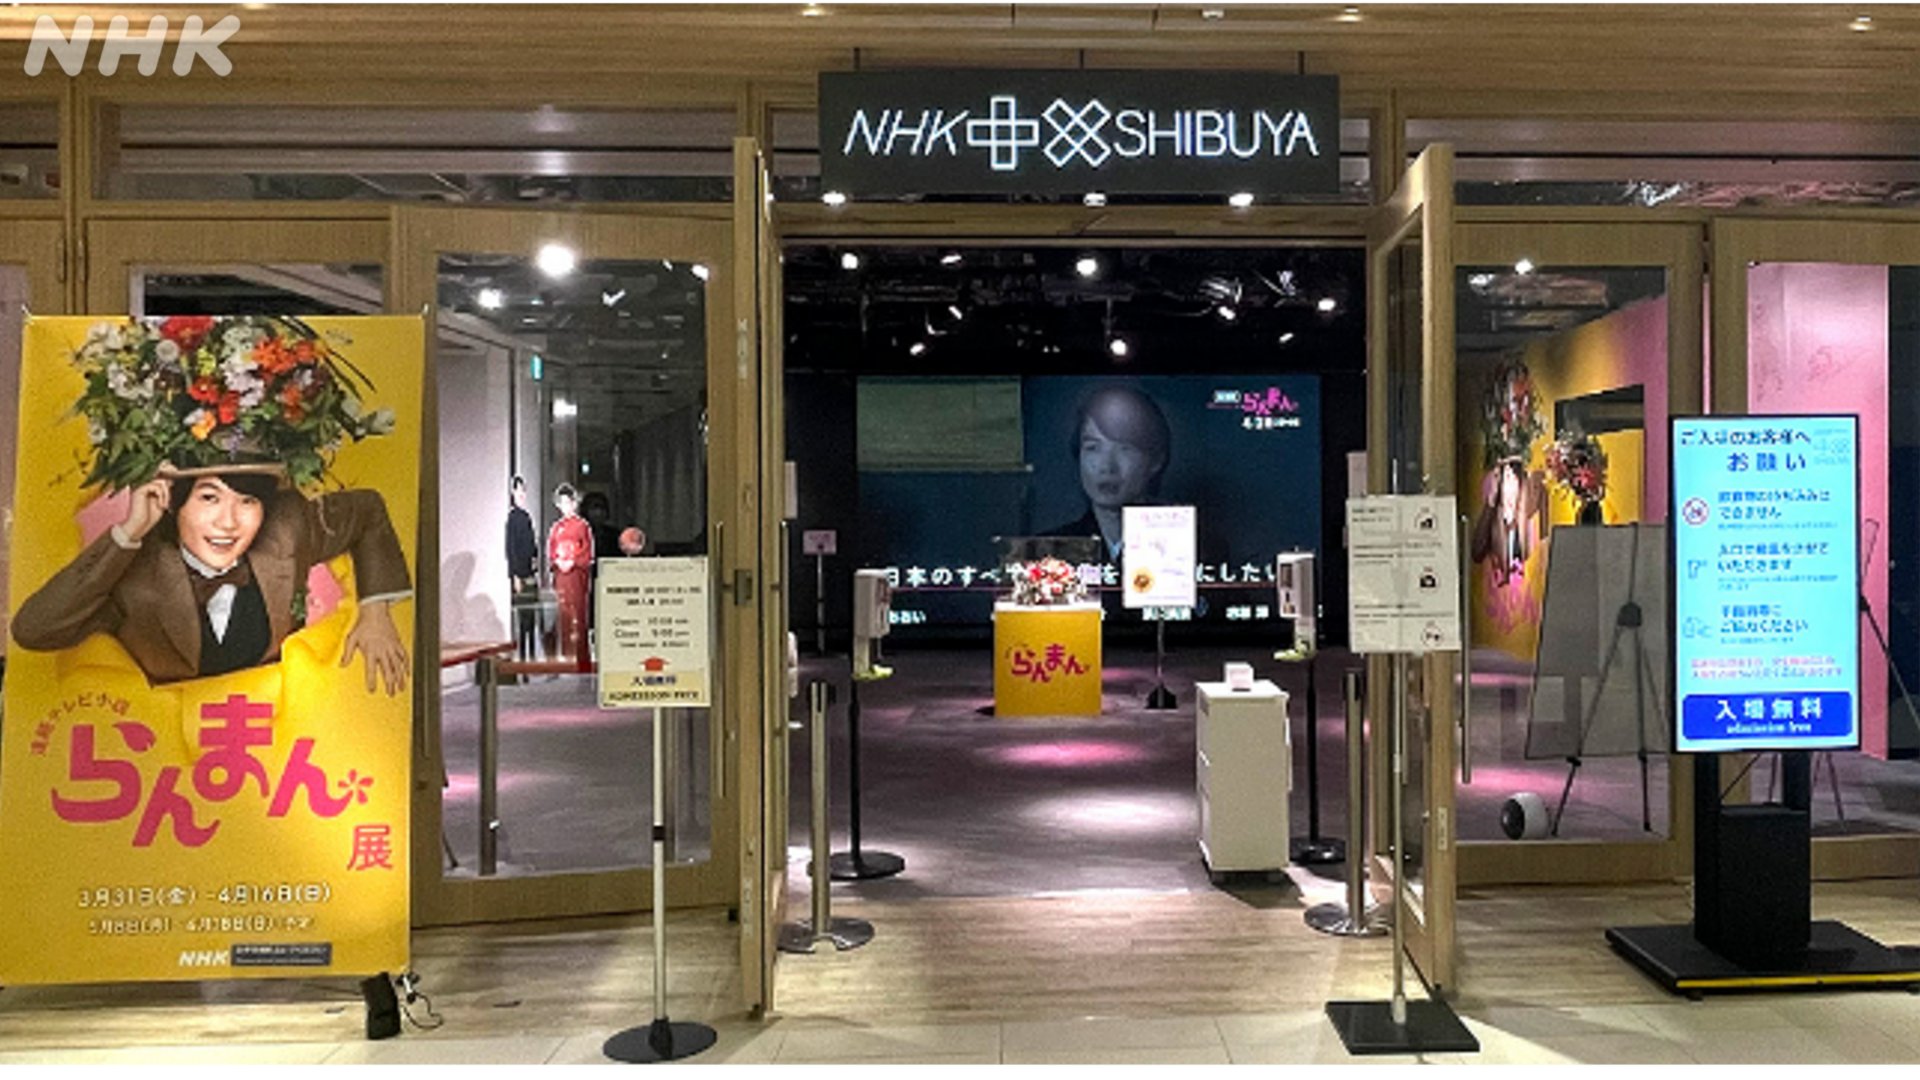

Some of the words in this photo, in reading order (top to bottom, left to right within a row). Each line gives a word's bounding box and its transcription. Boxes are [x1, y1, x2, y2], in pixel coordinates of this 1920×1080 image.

[843, 109, 969, 156] NHK
[1113, 109, 1320, 157] SHIBUYA
[1726, 451, 1806, 472] お願い
[1010, 643, 1086, 683] らんまん
[1715, 697, 1823, 721] 入場無料
[51, 694, 354, 847] らんまん
[346, 824, 394, 872] 展
[178, 950, 229, 967] NHK
